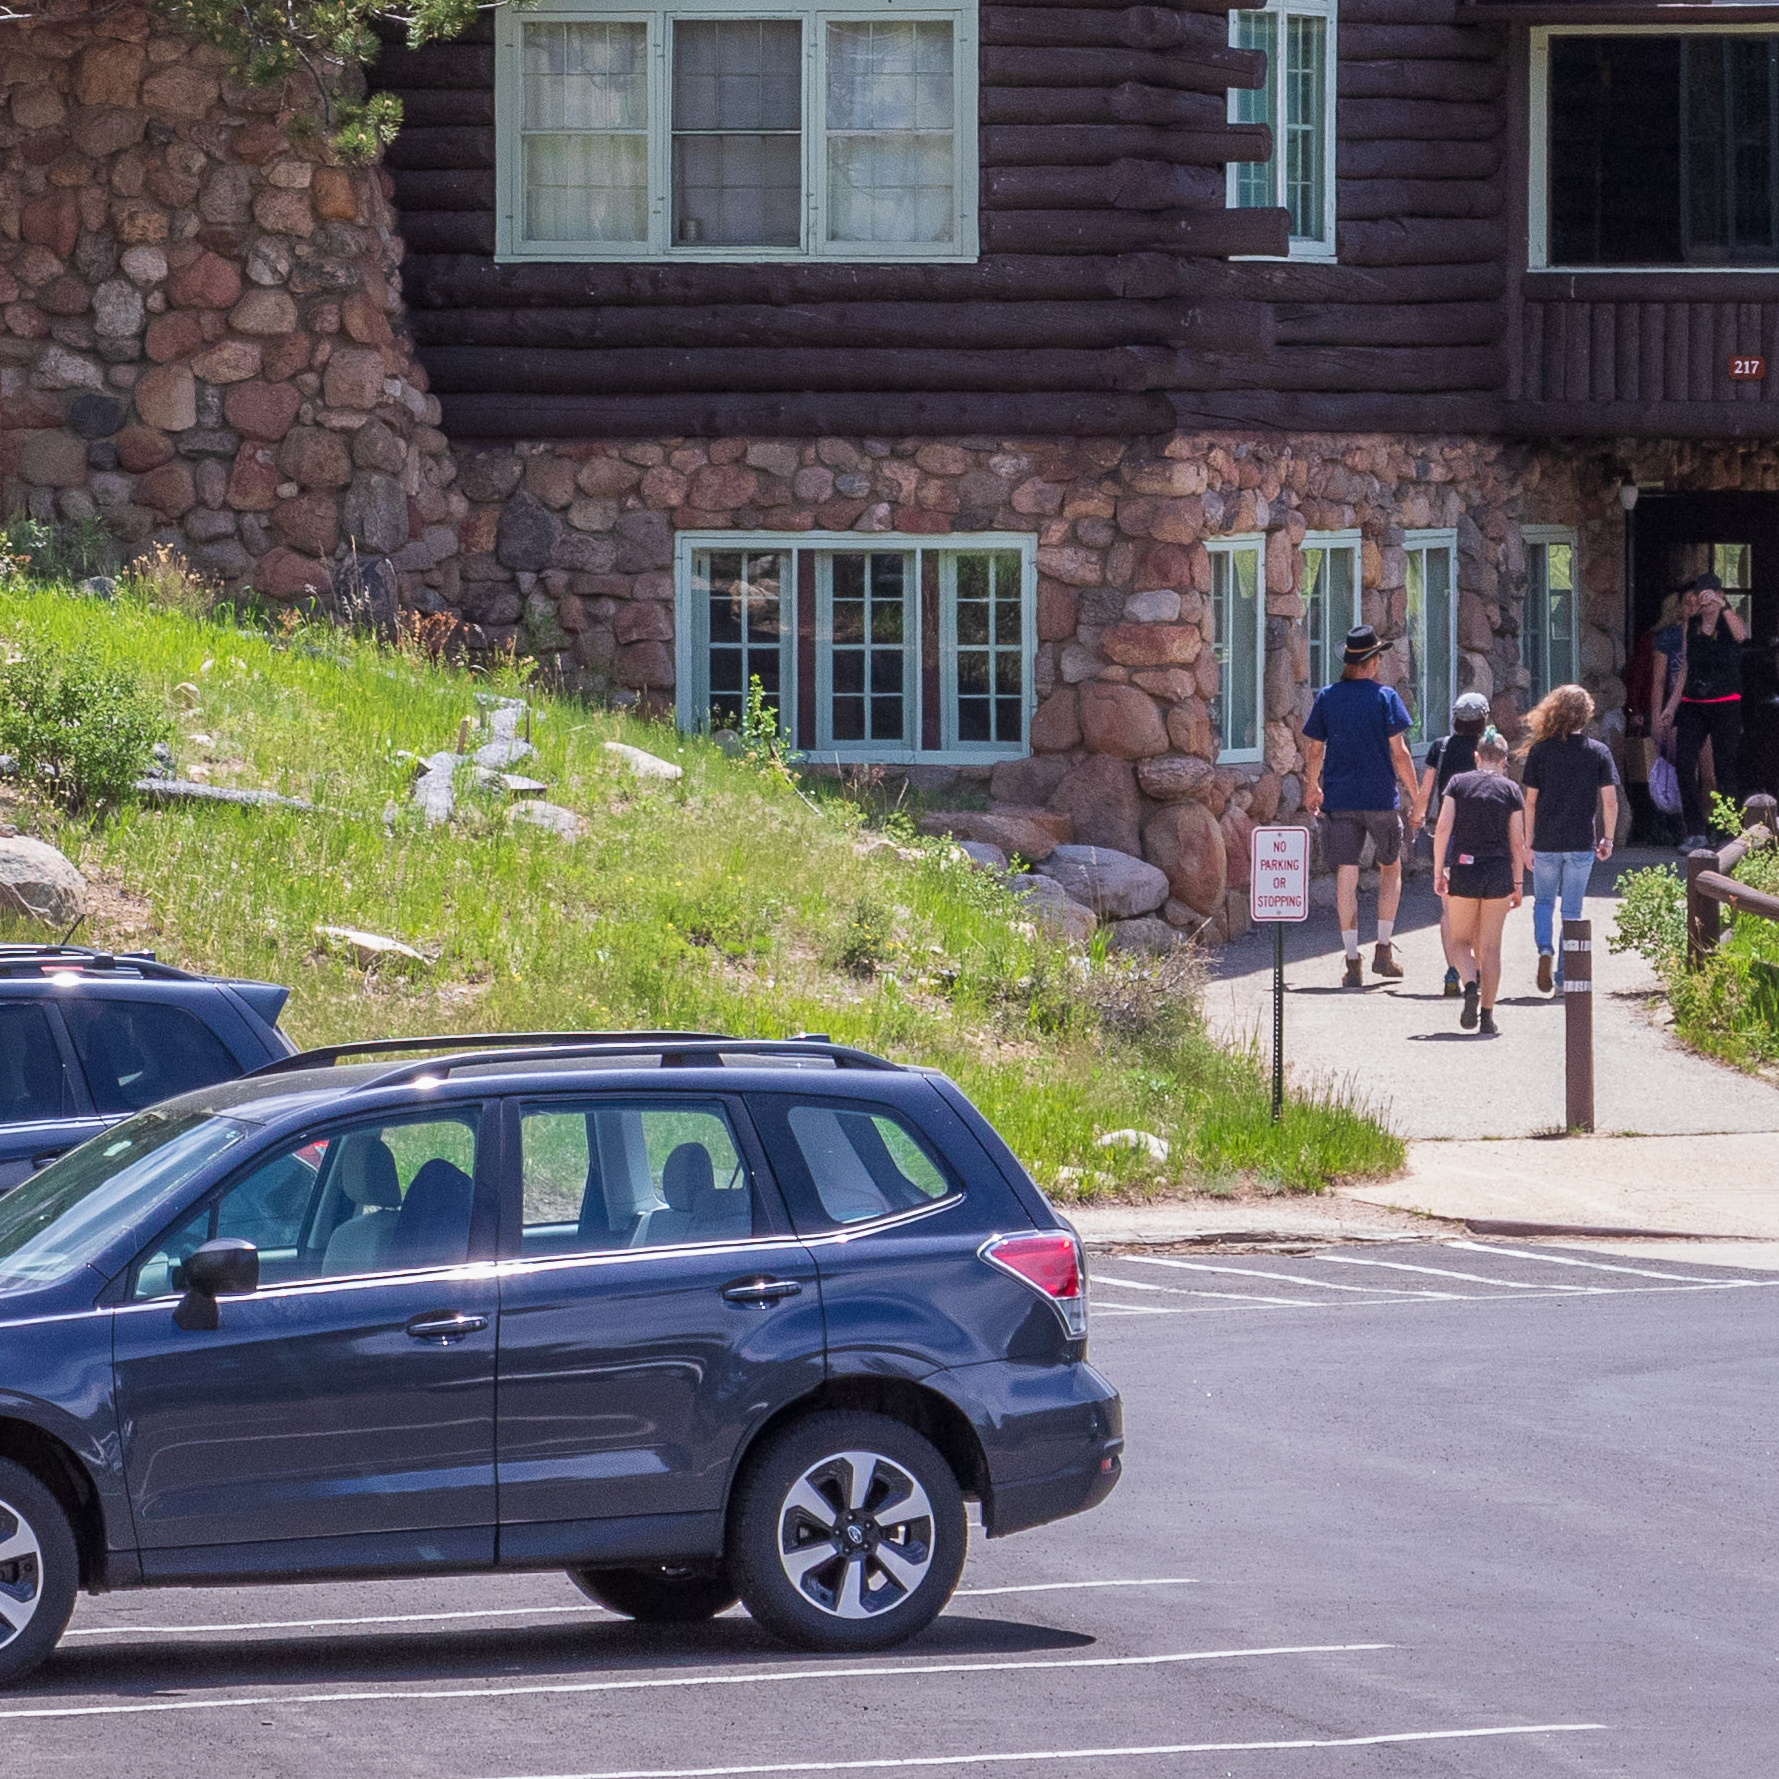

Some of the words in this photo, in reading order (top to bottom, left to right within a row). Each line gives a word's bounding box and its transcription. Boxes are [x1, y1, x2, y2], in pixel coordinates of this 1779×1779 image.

[1734, 360, 1760, 374] 217
[1273, 841, 1286, 852] NO
[1260, 859, 1299, 871] PARKING
[1273, 877, 1286, 889] OR
[1257, 895, 1302, 907] STOPPING
